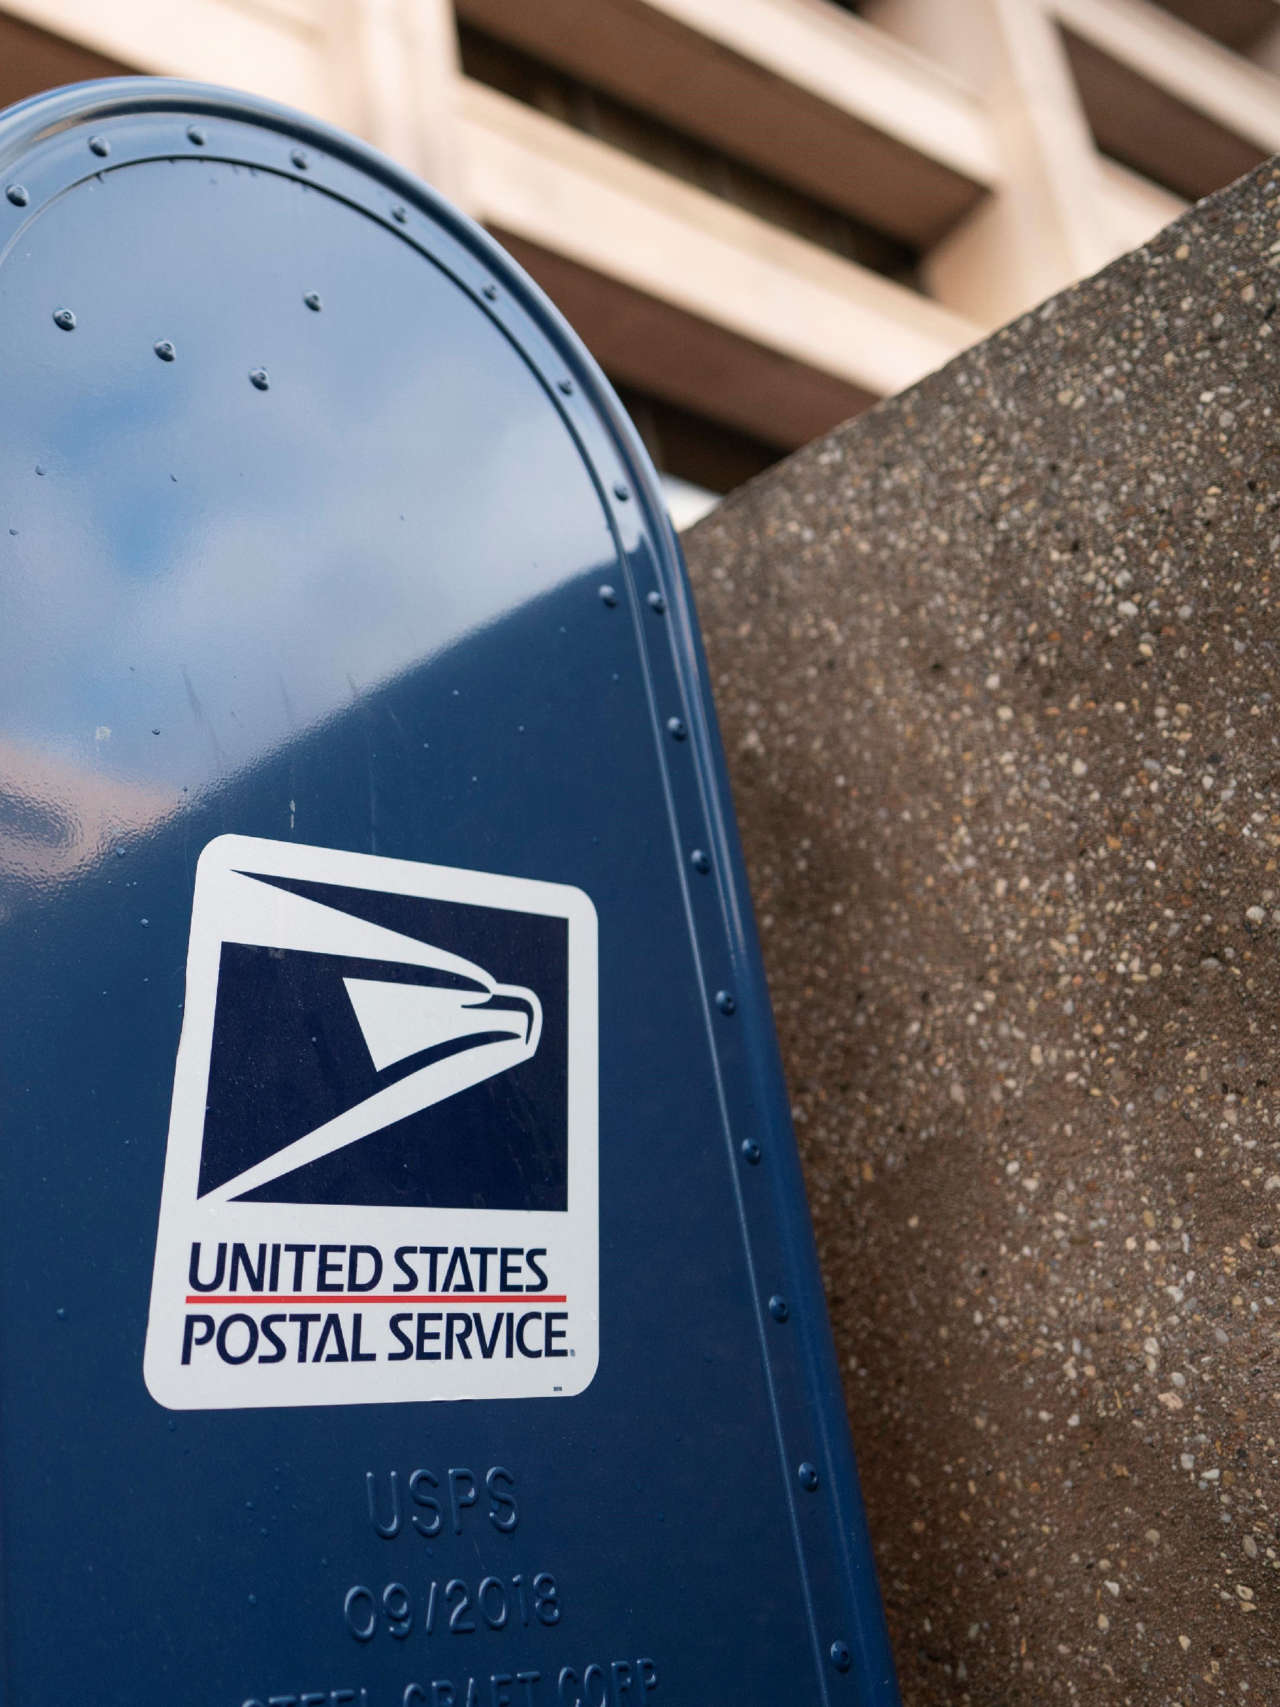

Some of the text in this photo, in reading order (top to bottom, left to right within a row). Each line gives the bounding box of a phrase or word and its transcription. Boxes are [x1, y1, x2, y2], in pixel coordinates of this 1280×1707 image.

[188, 1241, 549, 1293] UNITED STATES
[180, 1312, 377, 1366] POSTAL
[366, 1465, 521, 1540] USPS
[344, 1572, 562, 1643] 09/2018
